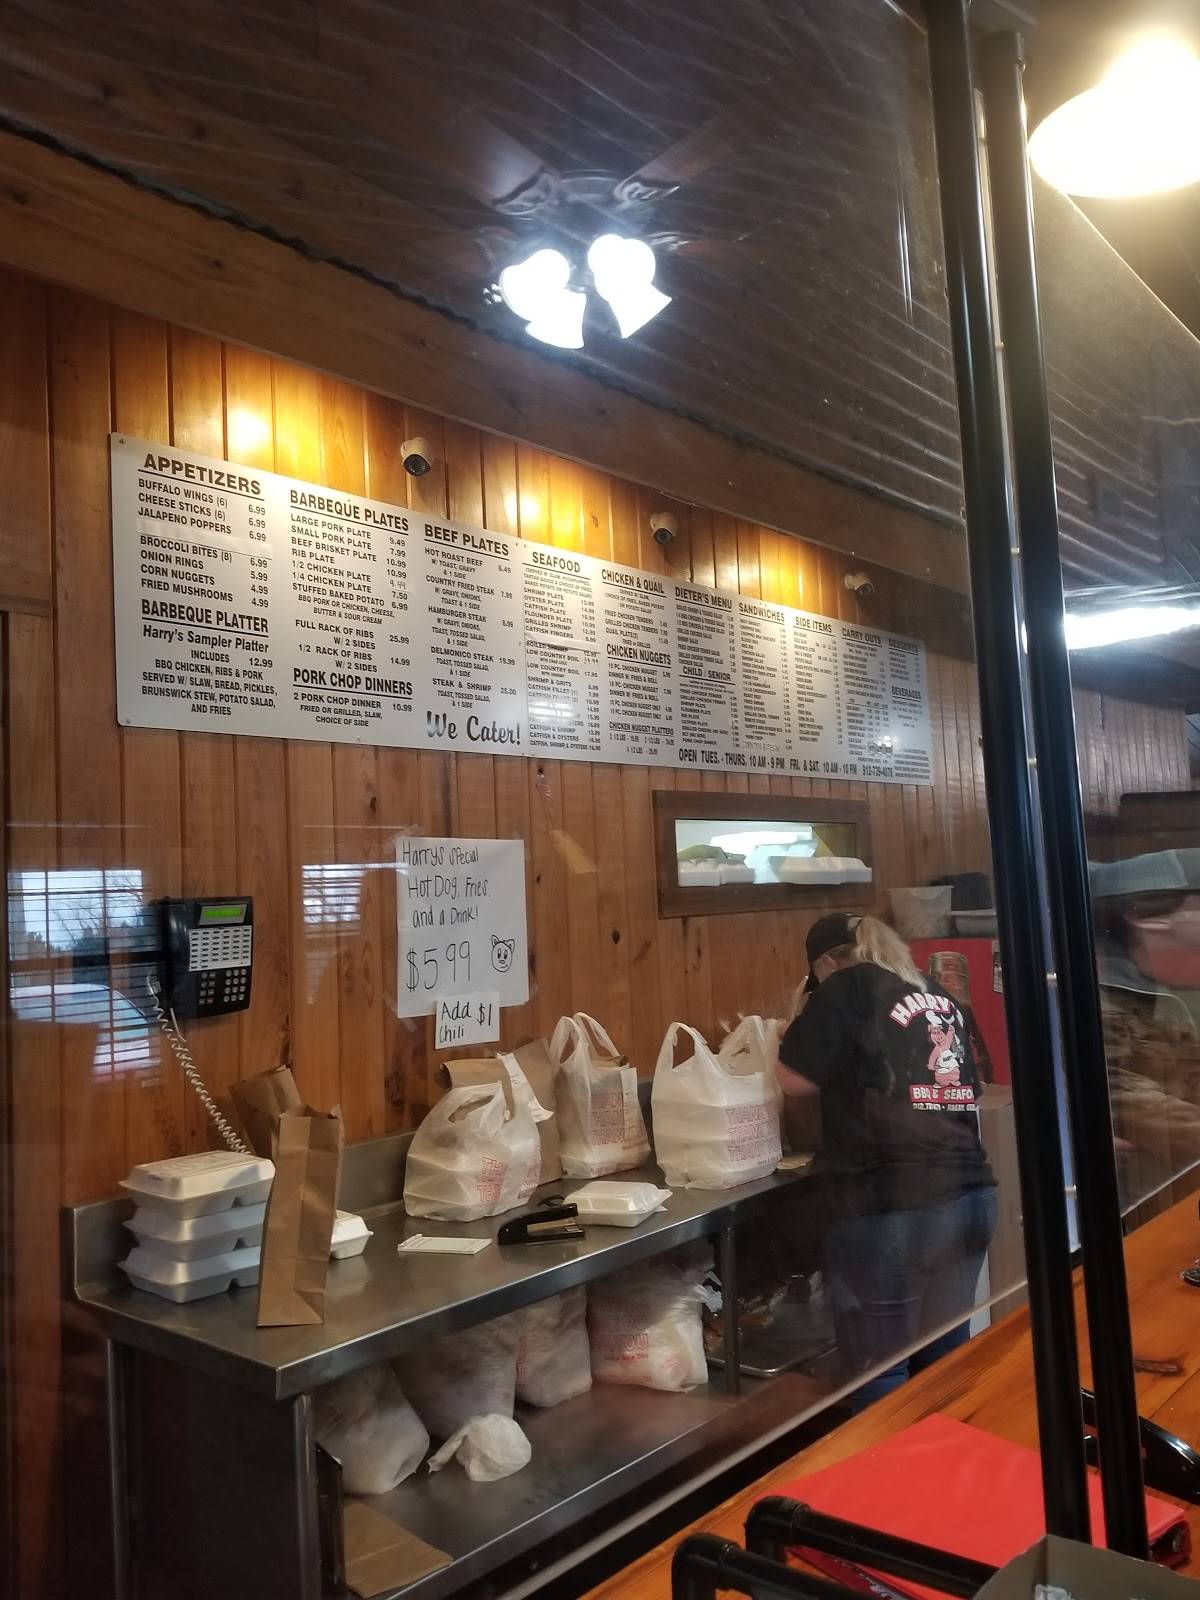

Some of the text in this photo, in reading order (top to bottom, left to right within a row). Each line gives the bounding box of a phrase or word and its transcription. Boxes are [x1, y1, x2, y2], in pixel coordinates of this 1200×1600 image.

[144, 454, 261, 495] APPETIZERS
[138, 478, 266, 515] BUFFALO WINGS (6) 6.99
[138, 492, 266, 528] CHEESE STICKS (6) 6.99
[290, 490, 409, 531] BARBEQUE PLATES
[138, 507, 266, 541] JALAPENO POPPERS 6.99
[291, 514, 318, 526] LARGE
[322, 521, 344, 533] PORK
[347, 528, 371, 539] PLATE
[425, 524, 509, 556] BEEF PLATES
[140, 536, 268, 568] BROCCOLI BITES (8) 6.99
[291, 537, 406, 568] BEEF BRISKET PLATE 10.99
[425, 548, 439, 556] HOT
[442, 552, 464, 562] ROAST
[533, 552, 580, 573] SEAFOOD
[141, 550, 268, 581] ONION RINGS 5.99
[307, 563, 344, 577] CHICKEN
[347, 571, 371, 582] PLATE
[141, 564, 268, 594] CORN NUGGETS 4.99
[292, 572, 304, 580] 1/4
[308, 574, 344, 588] CHICKEN
[348, 582, 371, 593] PLATE
[426, 575, 455, 587] COUNTRY
[458, 582, 475, 590] FRIED
[477, 586, 495, 595] STEAK
[602, 569, 634, 586] CHICKEN
[644, 579, 664, 593] QUAIL
[141, 579, 268, 608] FRIED MUSHROOMS 4.99
[293, 583, 408, 610] STUFFED BAKED POTATO 6.99
[675, 587, 709, 603] DIETER'S
[711, 593, 732, 609] MENU
[142, 599, 268, 632] BARBEQUE PLATTER
[428, 606, 486, 622] HAMBURGER STEAK
[739, 603, 784, 622] SANDWICHES
[296, 620, 316, 629] FULL
[319, 623, 341, 633] RACK
[356, 629, 374, 638] RIBS
[389, 635, 409, 644] 25.99
[796, 616, 832, 633] SIDE ITEMS
[842, 628, 881, 644] CARRY OUTS
[144, 624, 268, 653] Harry's Sampler Platter
[431, 646, 471, 659] DELMONICO
[473, 654, 494, 662] STEAK
[607, 644, 671, 664] CHICKEN NUGGETS
[155, 659, 172, 670] BBQ
[175, 662, 213, 675] CHICKEN,
[216, 666, 233, 676] RIBS
[243, 670, 263, 680] PORK
[683, 666, 731, 681] CHILD SENIOR
[142, 672, 277, 696] SERVED W/ SLAW, BREAD, PICKLES,
[294, 668, 413, 695] PORK CHOP DINNERS
[433, 678, 454, 687] STEAK
[467, 683, 491, 691] SHRIMP
[142, 686, 276, 709] BRUNSWICK STEW, POTATO SALAD,
[302, 693, 324, 703] PORK
[327, 696, 349, 705] CHOP
[352, 698, 381, 709] DINNER
[393, 704, 412, 712] 10.99
[191, 704, 231, 715] AND FRIES
[427, 711, 520, 745] We Cater!
[679, 749, 697, 762] OPEN
[701, 750, 719, 763] TUES.
[750, 756, 756, 766] 10
[758, 756, 766, 767] AM
[776, 758, 784, 769] PM
[823, 762, 829, 773] 10
[831, 763, 838, 773] AM
[850, 764, 857, 774] PM
[413, 905, 478, 928] and a Drink!
[442, 1001, 491, 1025] Add $1
